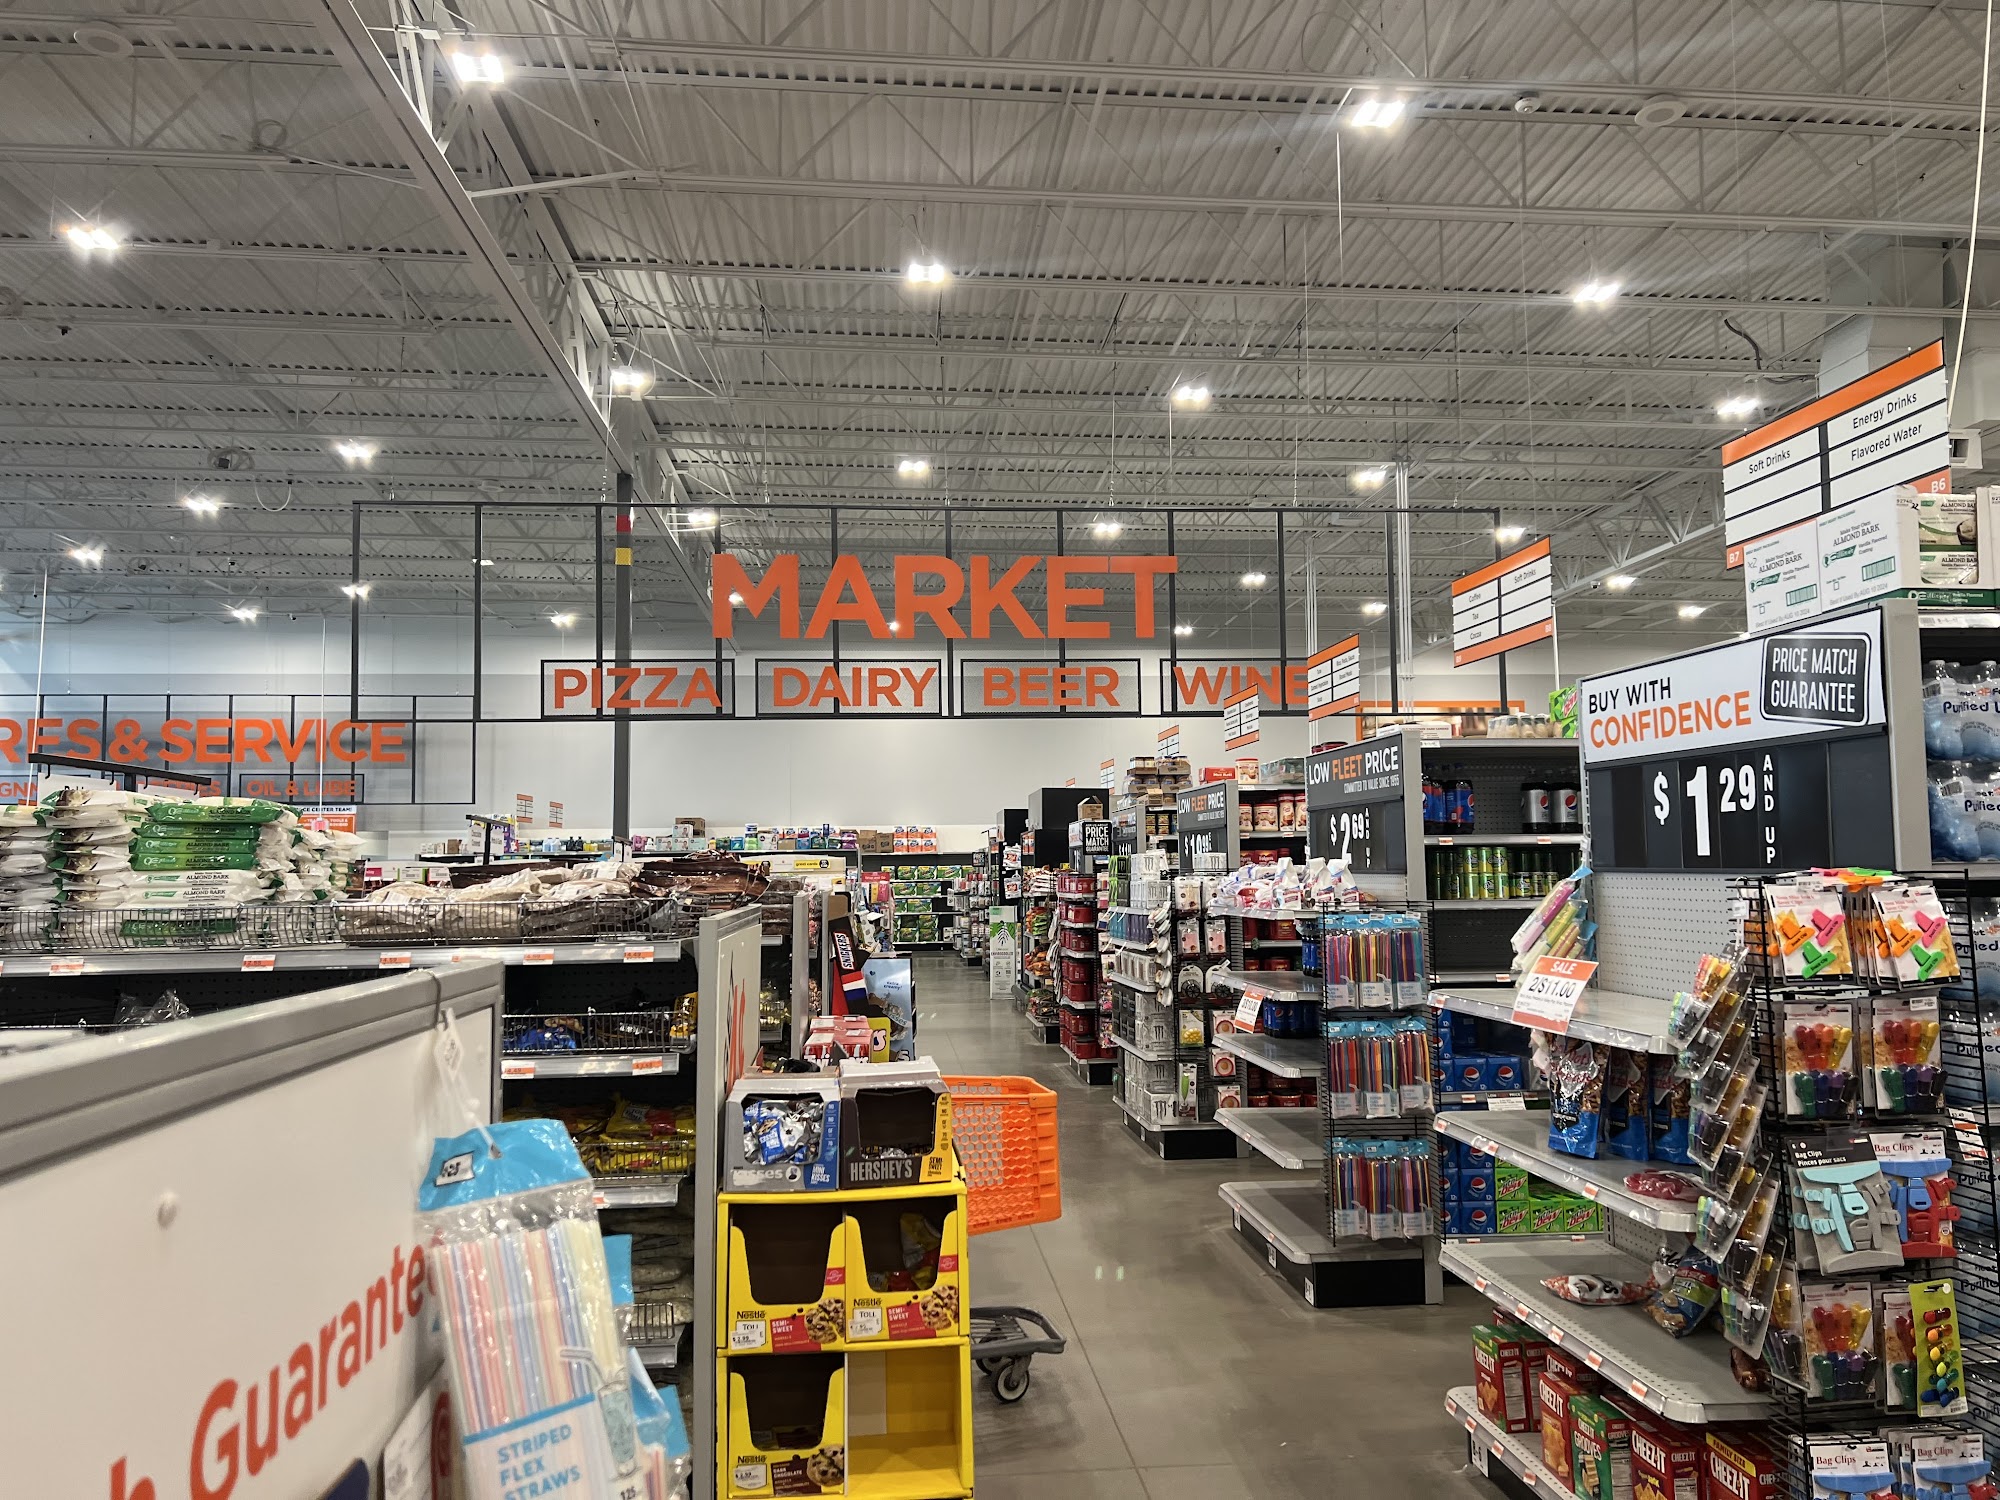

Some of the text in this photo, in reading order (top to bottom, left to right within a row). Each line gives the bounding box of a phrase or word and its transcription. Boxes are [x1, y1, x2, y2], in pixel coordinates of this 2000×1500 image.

[1853, 392, 1917, 429] Energy Drinks
[1851, 423, 1922, 461] Flavored Water
[1749, 449, 1791, 474] Soft Drinks
[1931, 478, 1946, 493] B6
[1833, 524, 1880, 546] ALMOND BARK
[1729, 551, 1740, 564] B7
[1758, 553, 1802, 574] ALMOND BARK
[1514, 569, 1537, 584] Soft Drinks
[711, 553, 1178, 639] MARKET
[1468, 593, 1482, 603] Coffee
[1469, 631, 1482, 640] Cocoa
[1772, 647, 1858, 676] PRICE MATCH
[553, 666, 723, 709] PIZZA
[772, 666, 937, 707] DAIRY
[983, 666, 1121, 707] BEER
[1173, 665, 1309, 705] WINE
[1589, 677, 1671, 714] BUY WITH
[1770, 679, 1856, 713] GUARANTEE
[1943, 701, 1989, 714] Purified
[1590, 690, 1752, 749] CONFIDENCE
[108, 718, 149, 763] &
[157, 718, 406, 763] SERVICE
[1308, 746, 1399, 785] LOW FLEET PRICE
[246, 780, 356, 796] OIL & LUBE
[1343, 781, 1362, 794] COMMITTED
[1367, 779, 1379, 790] VALUE
[1379, 777, 1389, 788] SINCE
[1763, 754, 1774, 812] AND
[1178, 791, 1224, 814] LOW FLEET PRICE
[1085, 826, 1109, 837] PRICE
[1085, 837, 1109, 846] MATCH
[1765, 826, 1776, 864] UP
[837, 933, 854, 969] SNICKERS
[1550, 961, 1578, 975] SALE
[1528, 976, 1577, 998] 2/$11.00
[1795, 1150, 1822, 1159] Bag Clips
[1874, 1142, 1914, 1153] Bag Clips
[812, 1164, 826, 1174] MINI
[850, 1158, 913, 1181] HERSHEY'S
[1819, 1157, 1831, 1165] pour
[811, 1173, 830, 1183] KISSES
[888, 1306, 906, 1315] SEMI-
[889, 1312, 909, 1321] SWEET
[771, 1320, 790, 1328] SEMI-
[772, 1325, 793, 1334] SWEET
[497, 1426, 572, 1465] STRIPED
[1574, 1430, 1602, 1461] GROOVES
[1713, 1438, 1746, 1469] FAMILY SIZE
[1917, 1447, 1953, 1458] Bag Clips
[1816, 1455, 1856, 1465] Bag Clips
[500, 1460, 545, 1487] FLEX
[504, 1469, 581, 1500] STRAWS
